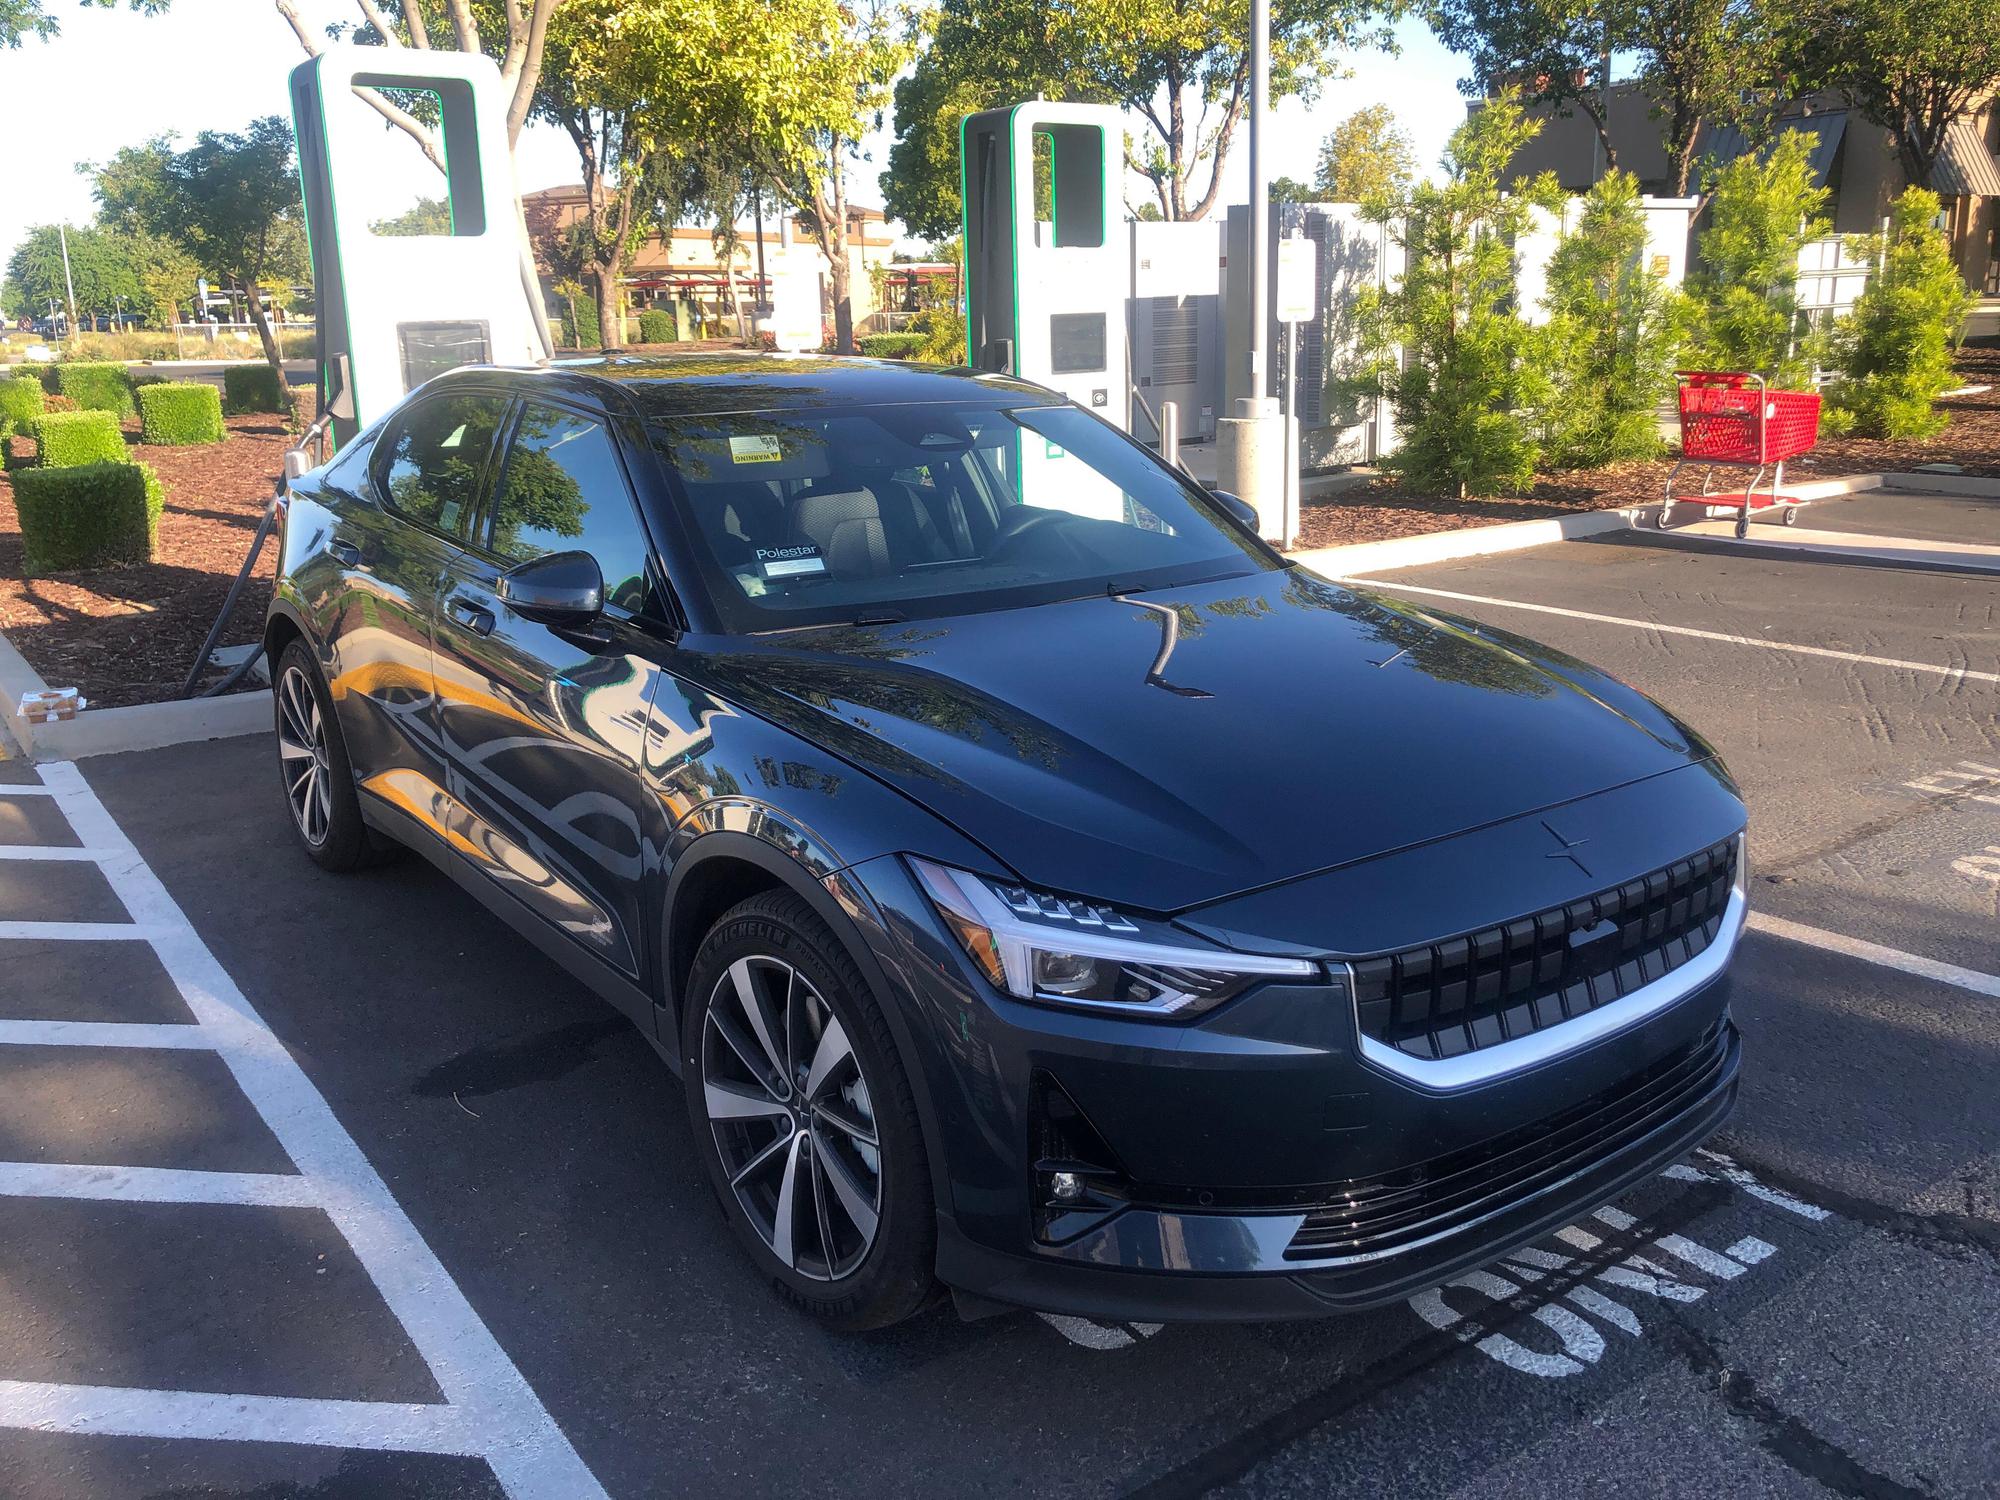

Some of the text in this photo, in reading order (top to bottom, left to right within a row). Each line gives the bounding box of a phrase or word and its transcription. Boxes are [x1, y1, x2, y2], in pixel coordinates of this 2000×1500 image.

[735, 454, 770, 463] WARNING
[756, 546, 817, 560] Polestar
[712, 920, 786, 948] MICHELIN
[1407, 1147, 1834, 1378] ONLY
